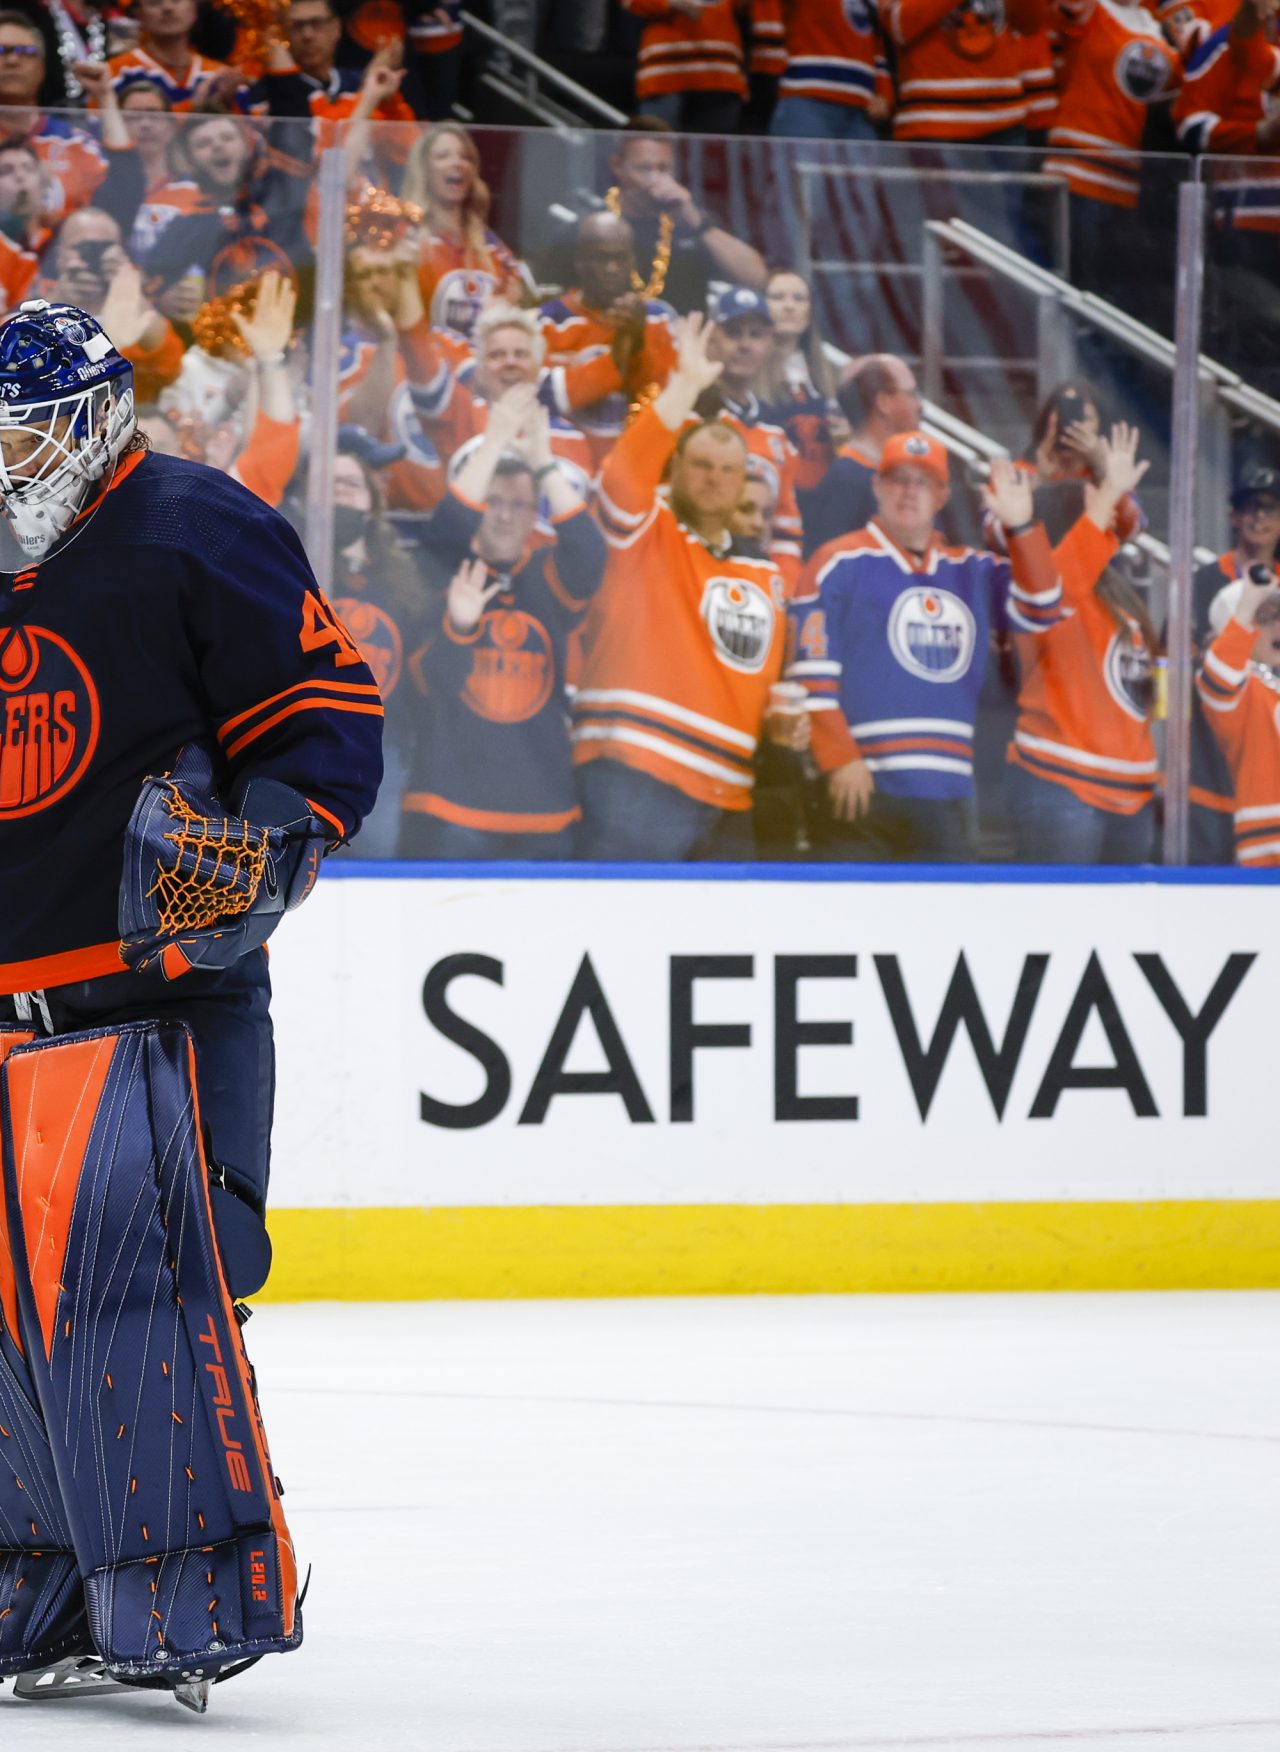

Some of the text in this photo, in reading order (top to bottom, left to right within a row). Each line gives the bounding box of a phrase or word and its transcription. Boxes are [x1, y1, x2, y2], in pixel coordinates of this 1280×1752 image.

[419, 948, 1258, 1130] SAFEWAY
[198, 1313, 252, 1493] TRUE
[249, 1551, 267, 1602] L20.2
